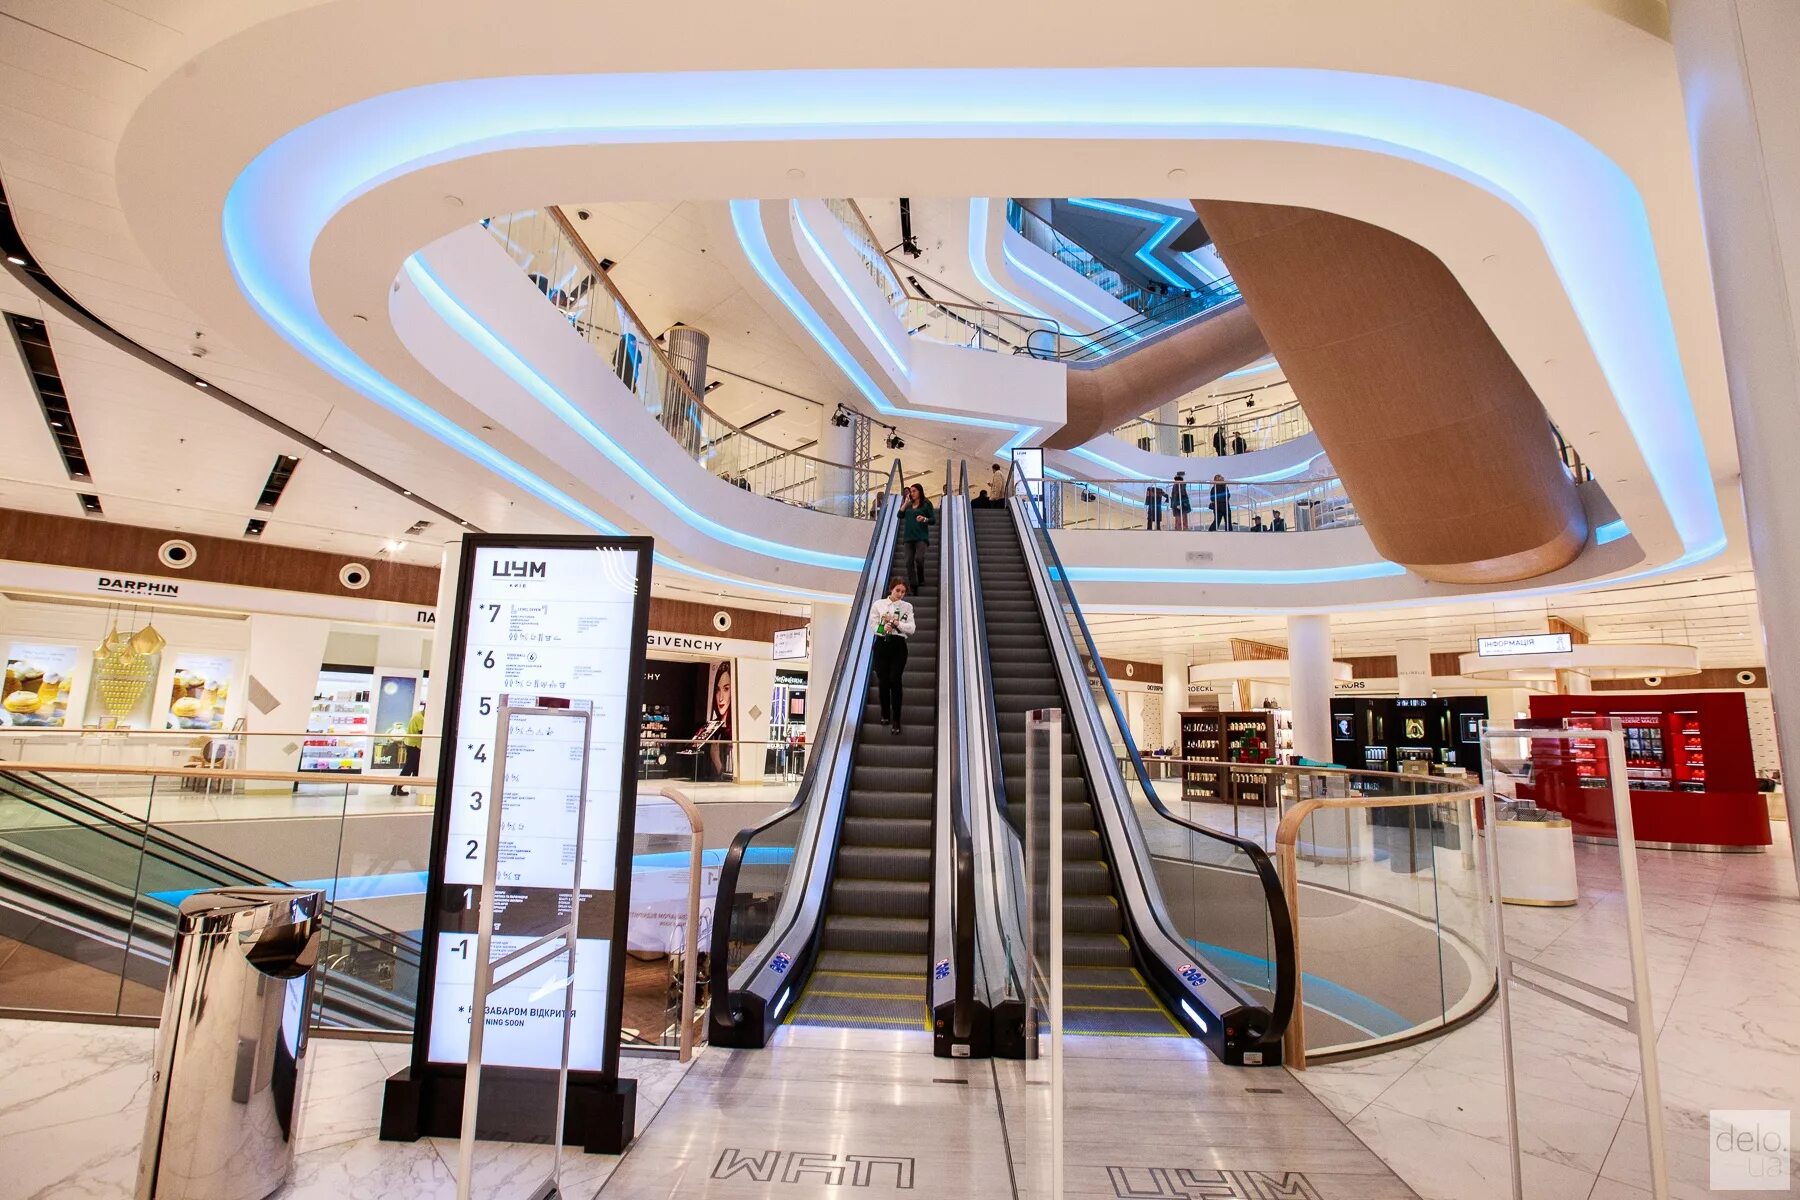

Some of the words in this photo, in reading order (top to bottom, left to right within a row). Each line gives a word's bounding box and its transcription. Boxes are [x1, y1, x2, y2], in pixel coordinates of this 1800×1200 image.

[492, 560, 547, 578] ЦУМ
[98, 577, 179, 594] DARPHIN
[488, 604, 502, 623] 7
[647, 635, 723, 651] GIVENCHY
[1484, 638, 1535, 648] ІНФОРМАЦІЯ
[483, 650, 495, 669] 6
[479, 696, 491, 715] 5
[473, 743, 487, 763] 4
[469, 791, 483, 811] 3
[465, 839, 479, 860] 2
[463, 888, 473, 910] 1
[450, 939, 468, 960] -1
[529, 1007, 577, 1019] ВІДКРИТЯ
[504, 1019, 525, 1027] SOON
[1105, 1165, 1325, 1200] ЦУМ
